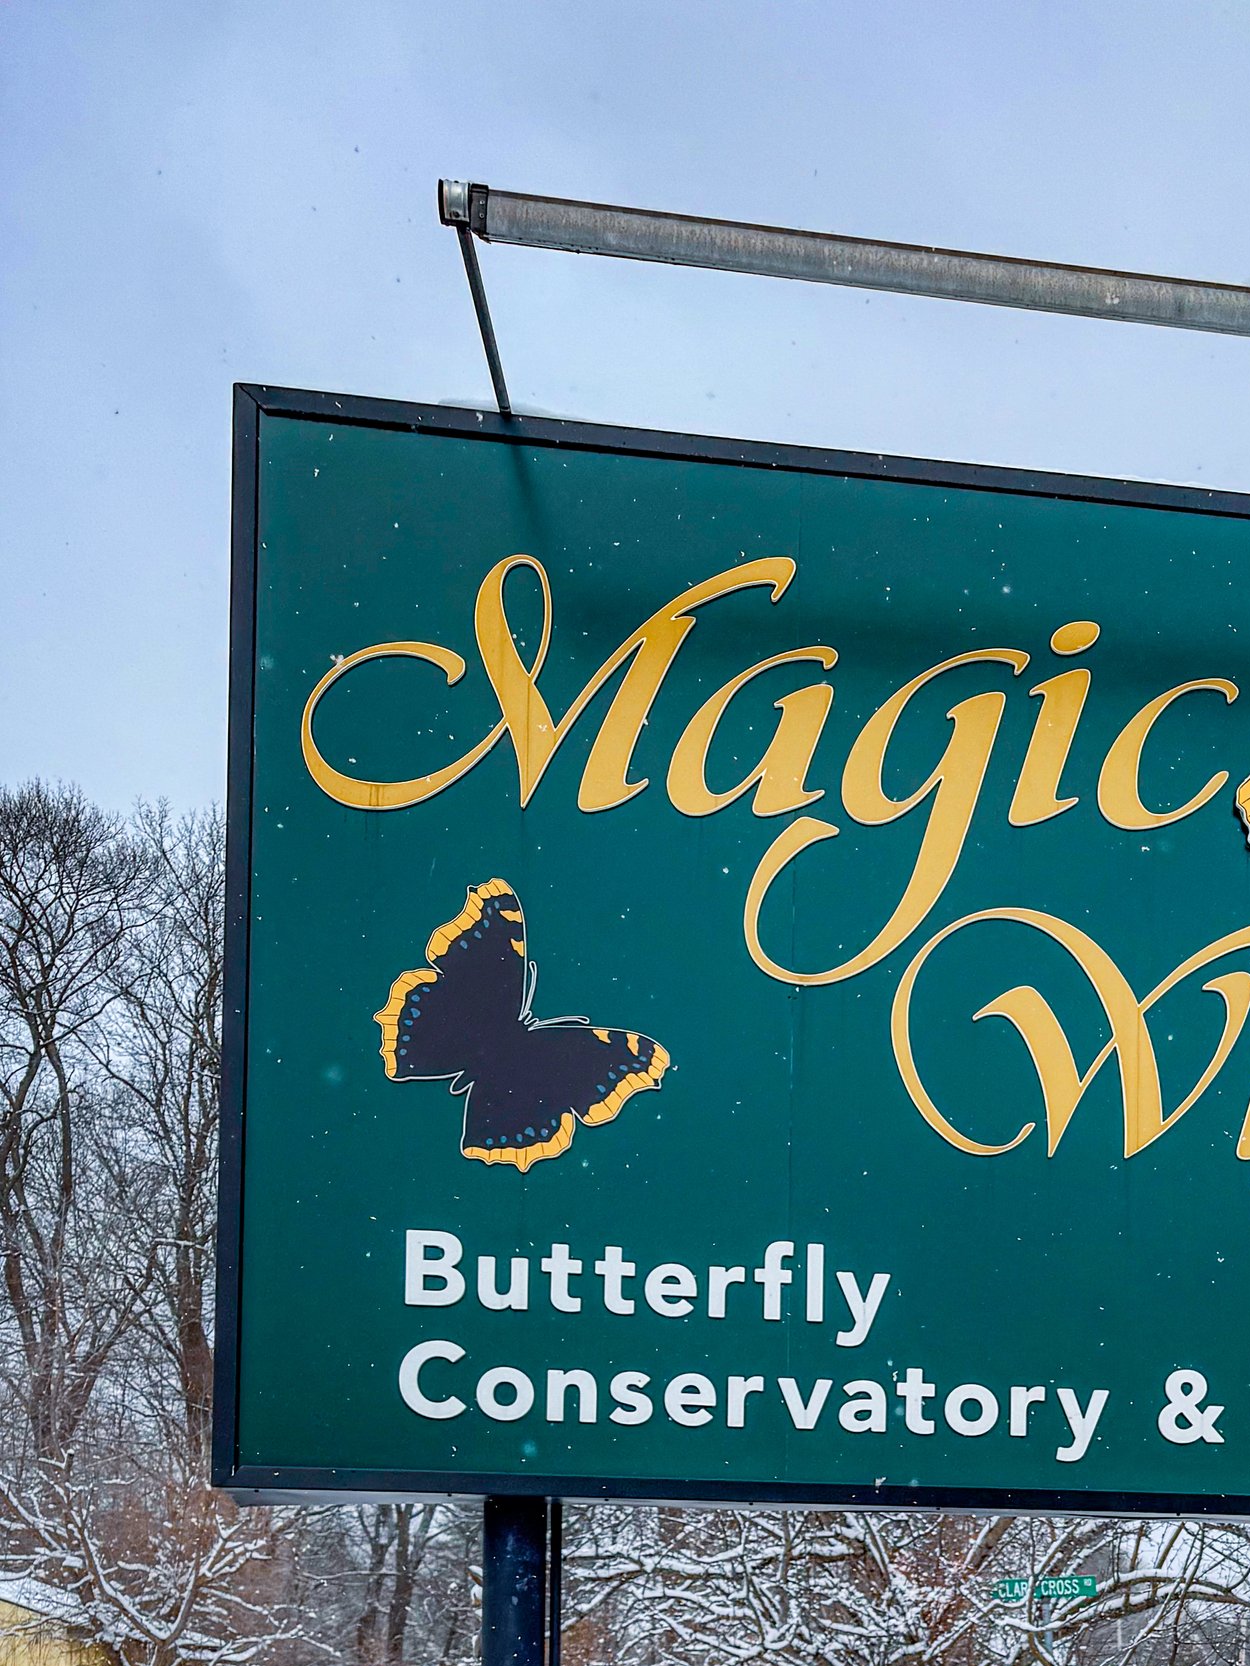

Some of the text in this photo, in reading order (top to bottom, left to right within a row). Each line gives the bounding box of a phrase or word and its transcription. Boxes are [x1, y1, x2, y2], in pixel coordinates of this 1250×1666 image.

[300, 553, 1241, 988] Magic
[403, 1228, 892, 1348] Butterfly
[397, 1339, 1111, 1463] Conservatory
[1157, 1368, 1226, 1445] &
[998, 1581, 1036, 1598] CLAR
[1040, 1578, 1080, 1596] CROSS
